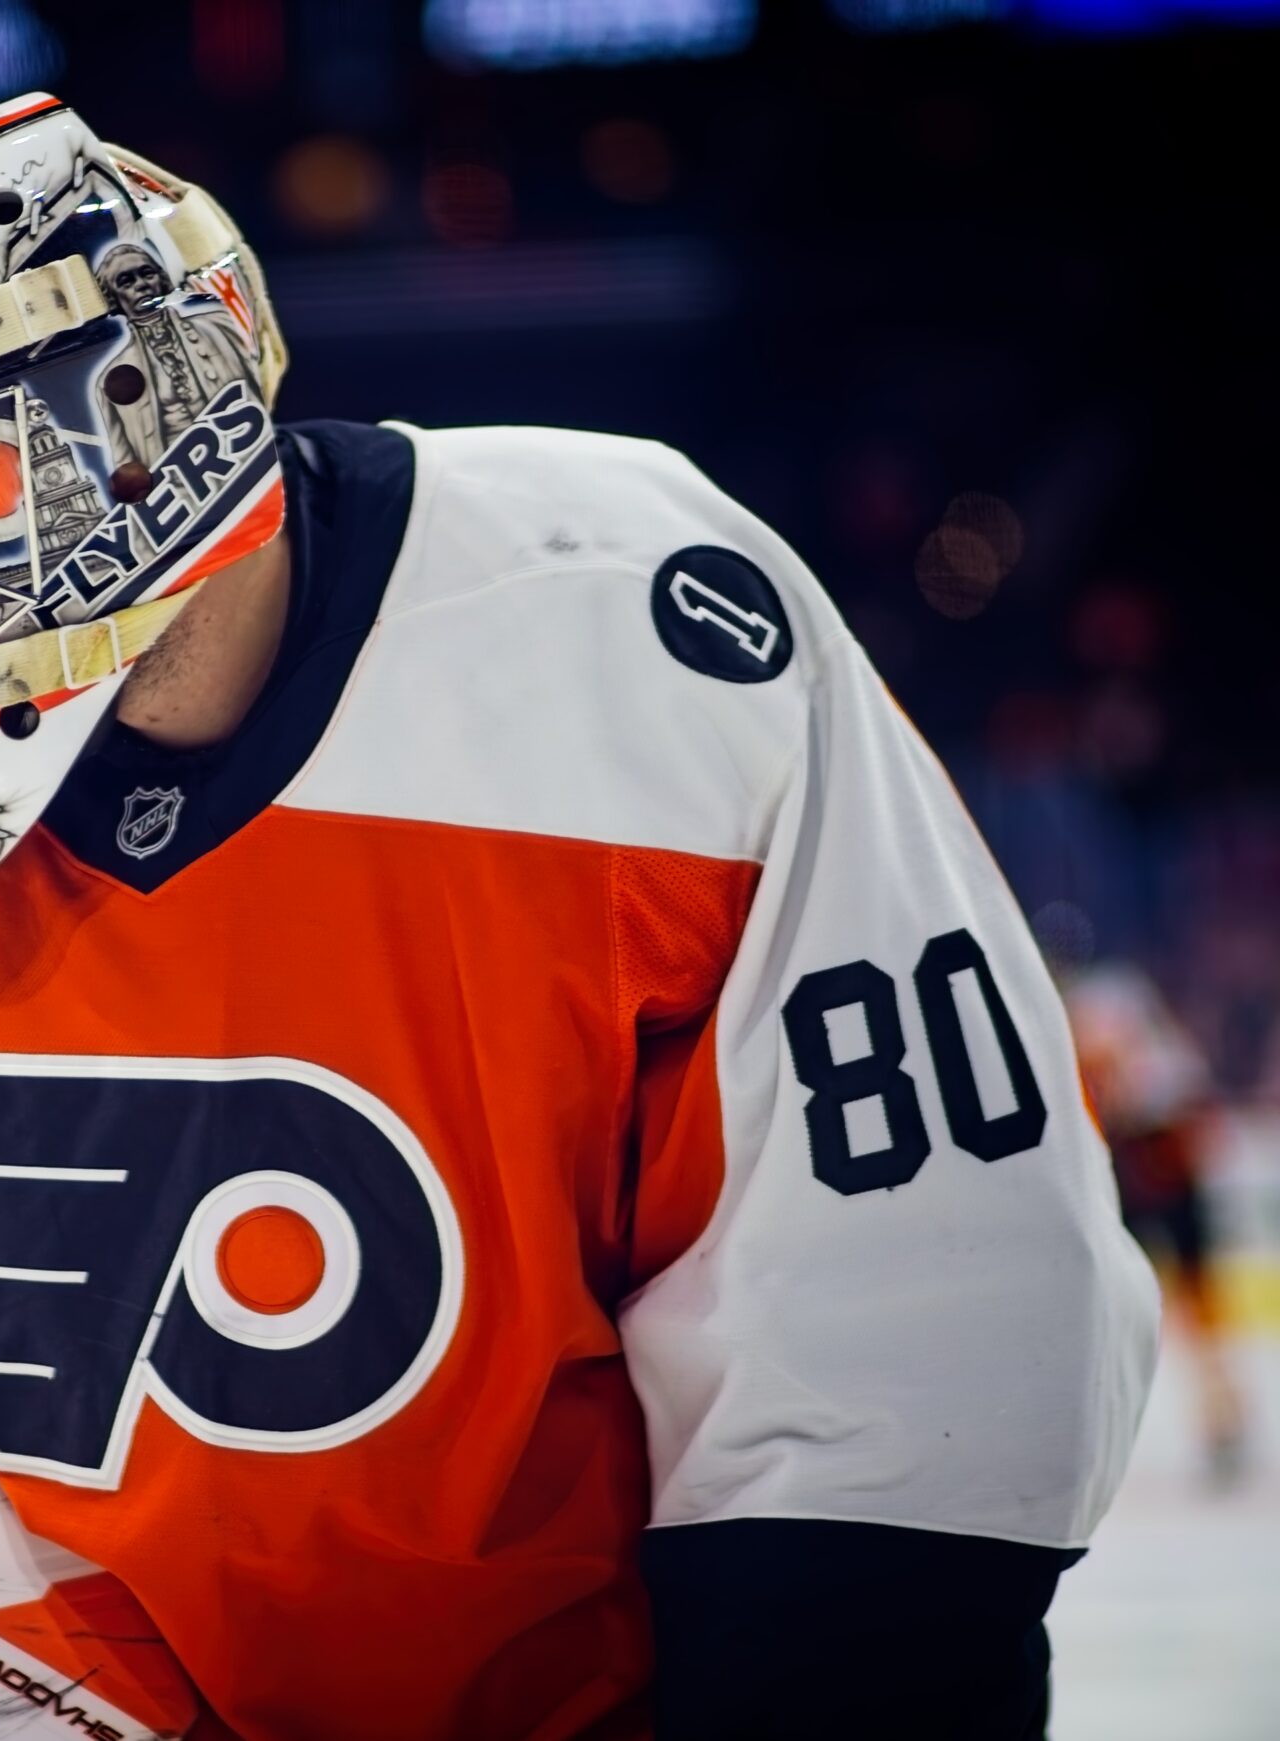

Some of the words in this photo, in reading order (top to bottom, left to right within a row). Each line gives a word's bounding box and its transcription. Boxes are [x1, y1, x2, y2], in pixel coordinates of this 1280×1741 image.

[28, 379, 265, 630] FLYERS
[669, 570, 778, 663] 1
[129, 806, 168, 841] NHL
[781, 927, 1048, 1197] 80
